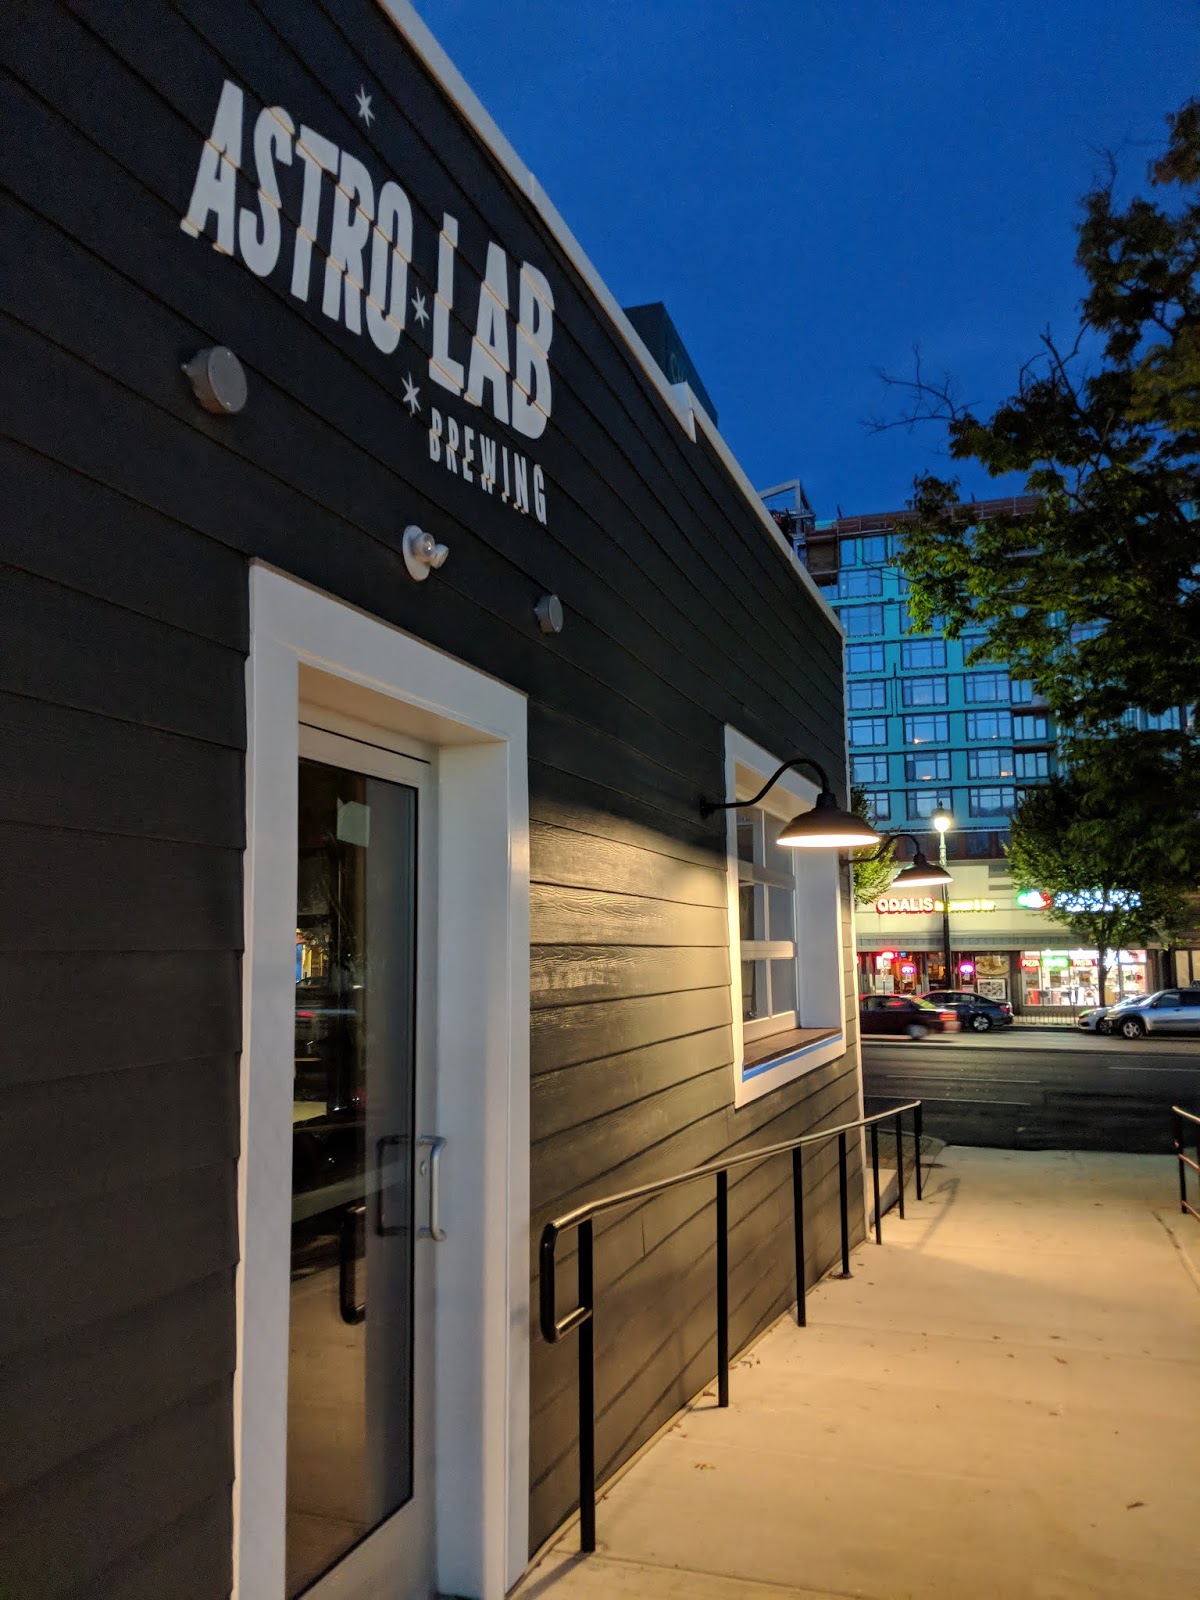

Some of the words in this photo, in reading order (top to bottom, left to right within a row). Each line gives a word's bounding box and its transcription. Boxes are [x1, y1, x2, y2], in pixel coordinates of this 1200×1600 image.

[180, 79, 414, 354] ASTRO
[429, 211, 555, 440] LAB
[429, 407, 547, 526] BREWING
[876, 898, 934, 914] ODALIS
